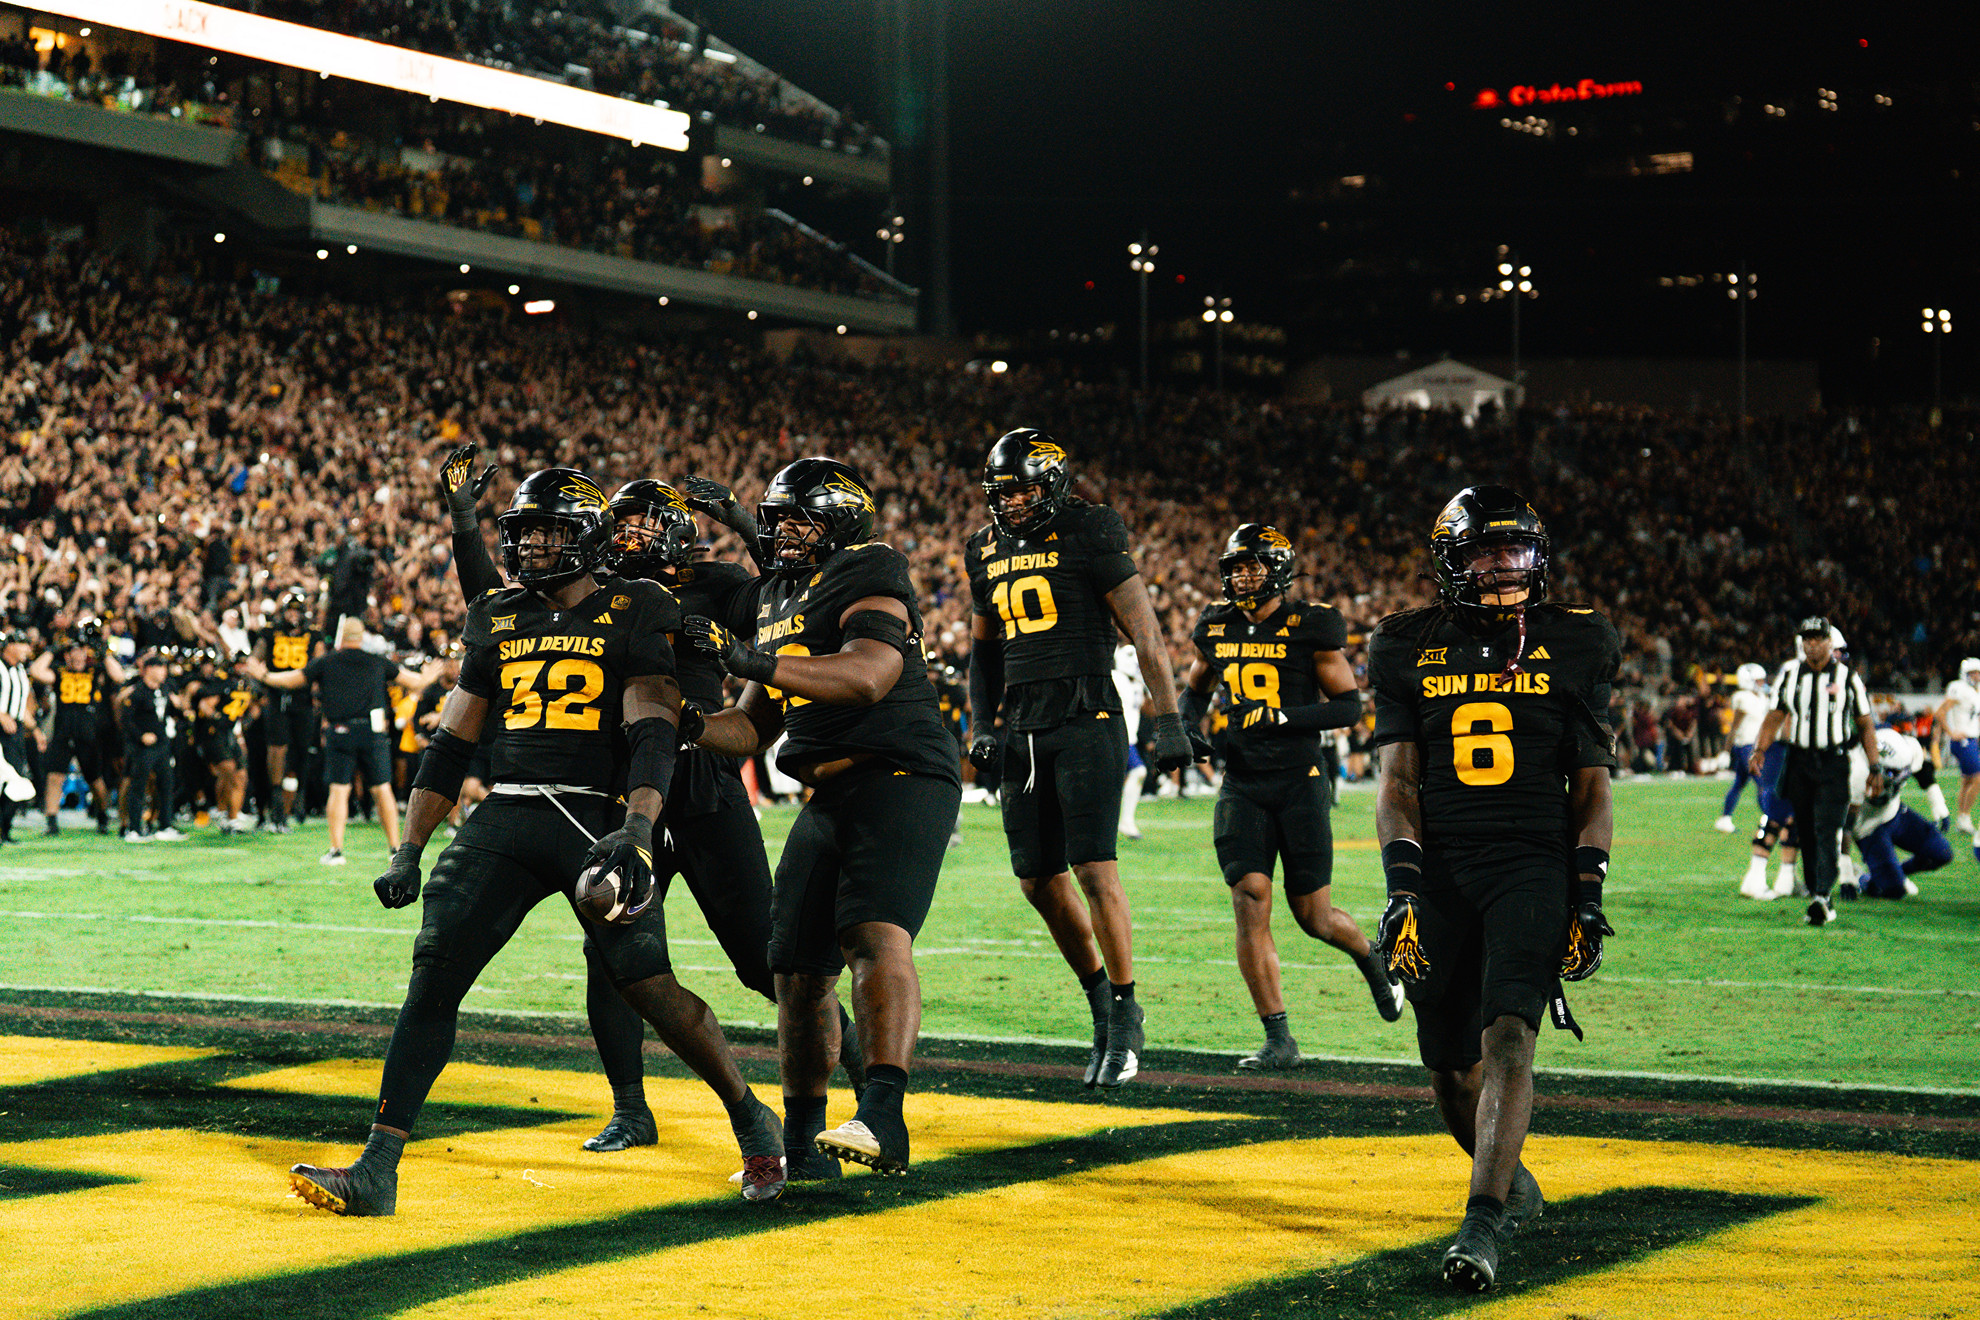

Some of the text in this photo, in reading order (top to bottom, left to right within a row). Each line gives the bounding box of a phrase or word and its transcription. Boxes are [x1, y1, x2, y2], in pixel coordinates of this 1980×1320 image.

[987, 551, 1059, 580] SUN DEVILS
[992, 575, 1058, 640] 10
[758, 614, 805, 646] SUN DEVILS
[499, 636, 605, 660] SUN DEVILS
[1215, 643, 1287, 659] SUN DEVILS
[60, 678, 93, 704] 92
[498, 659, 604, 731] 32
[1422, 675, 1468, 698] SUN
[1451, 702, 1514, 786] 6
